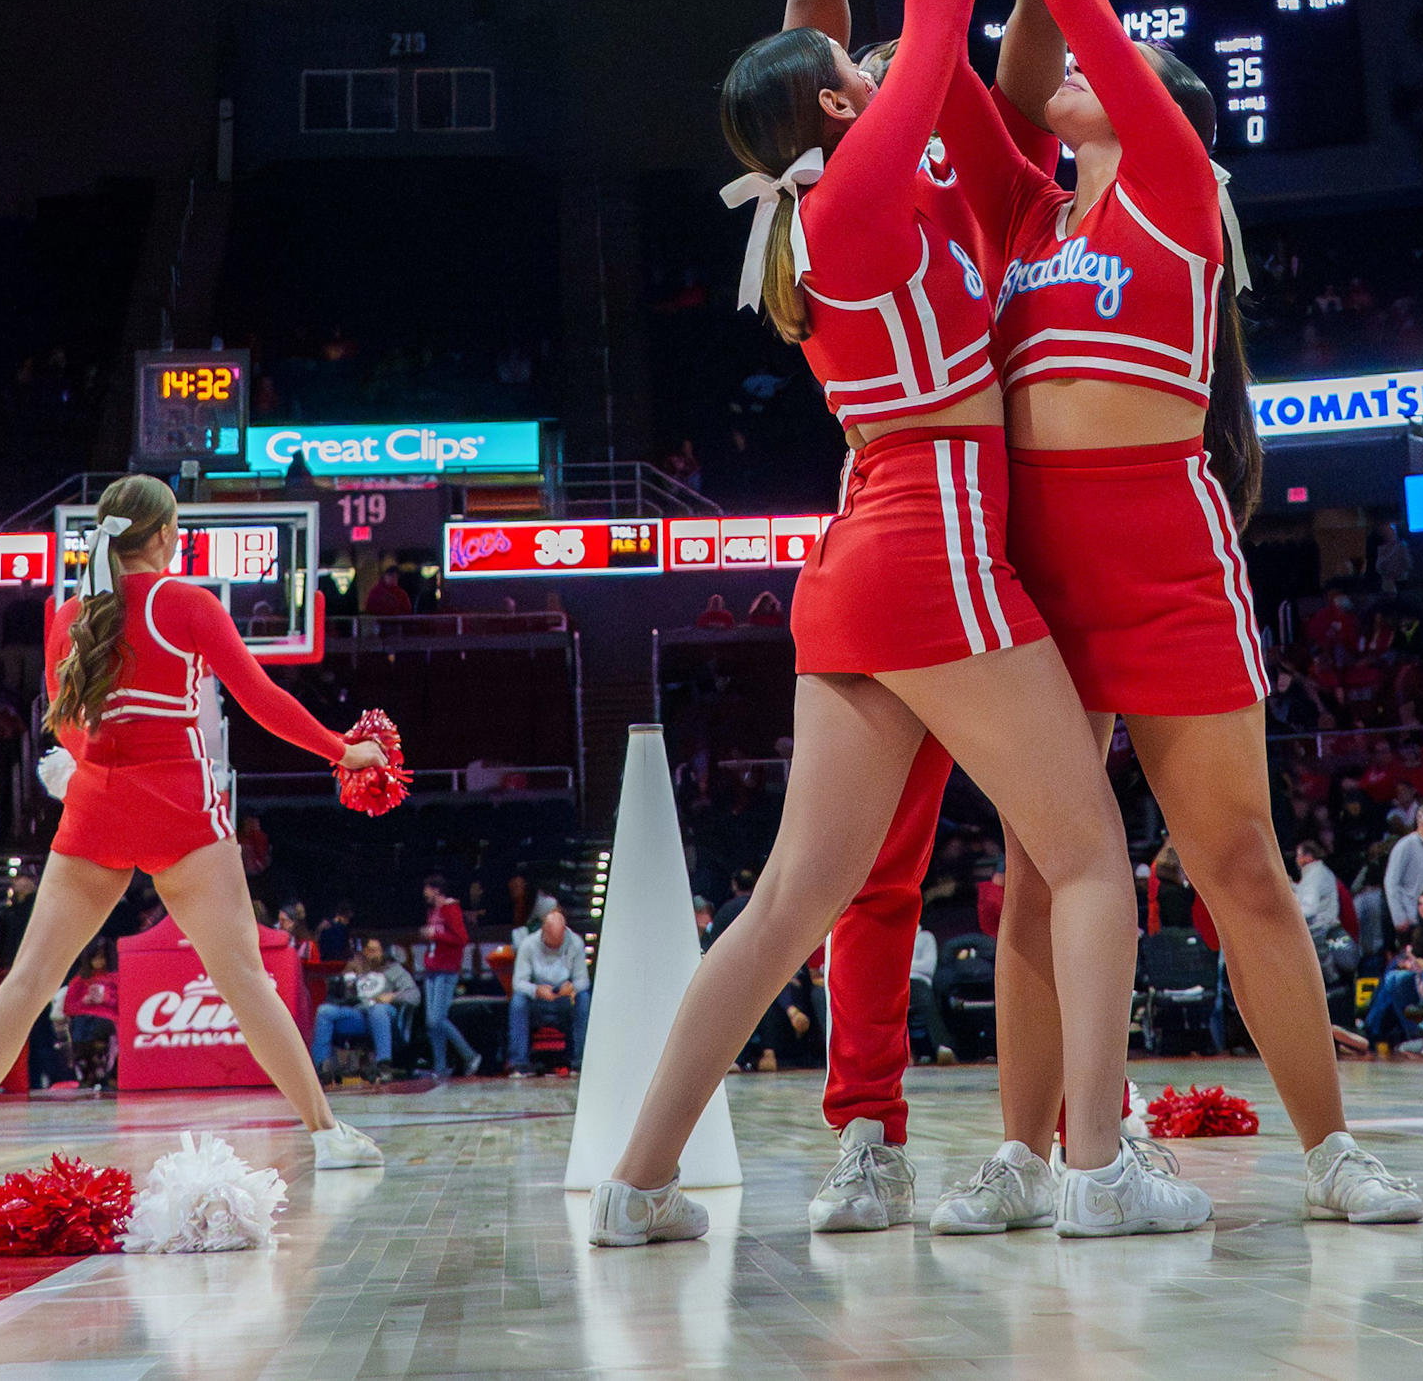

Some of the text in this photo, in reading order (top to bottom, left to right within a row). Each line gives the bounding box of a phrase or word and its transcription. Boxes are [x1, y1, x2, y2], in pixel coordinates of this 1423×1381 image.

[1228, 57, 1263, 89] 35
[1246, 115, 1265, 144] 0
[995, 236, 1134, 324] Bradley
[162, 368, 232, 401] 14:32
[266, 429, 479, 470] Great Clips
[338, 494, 386, 525] 119
[449, 528, 512, 568] Aces
[534, 529, 586, 565] 35
[640, 538, 650, 552] 0
